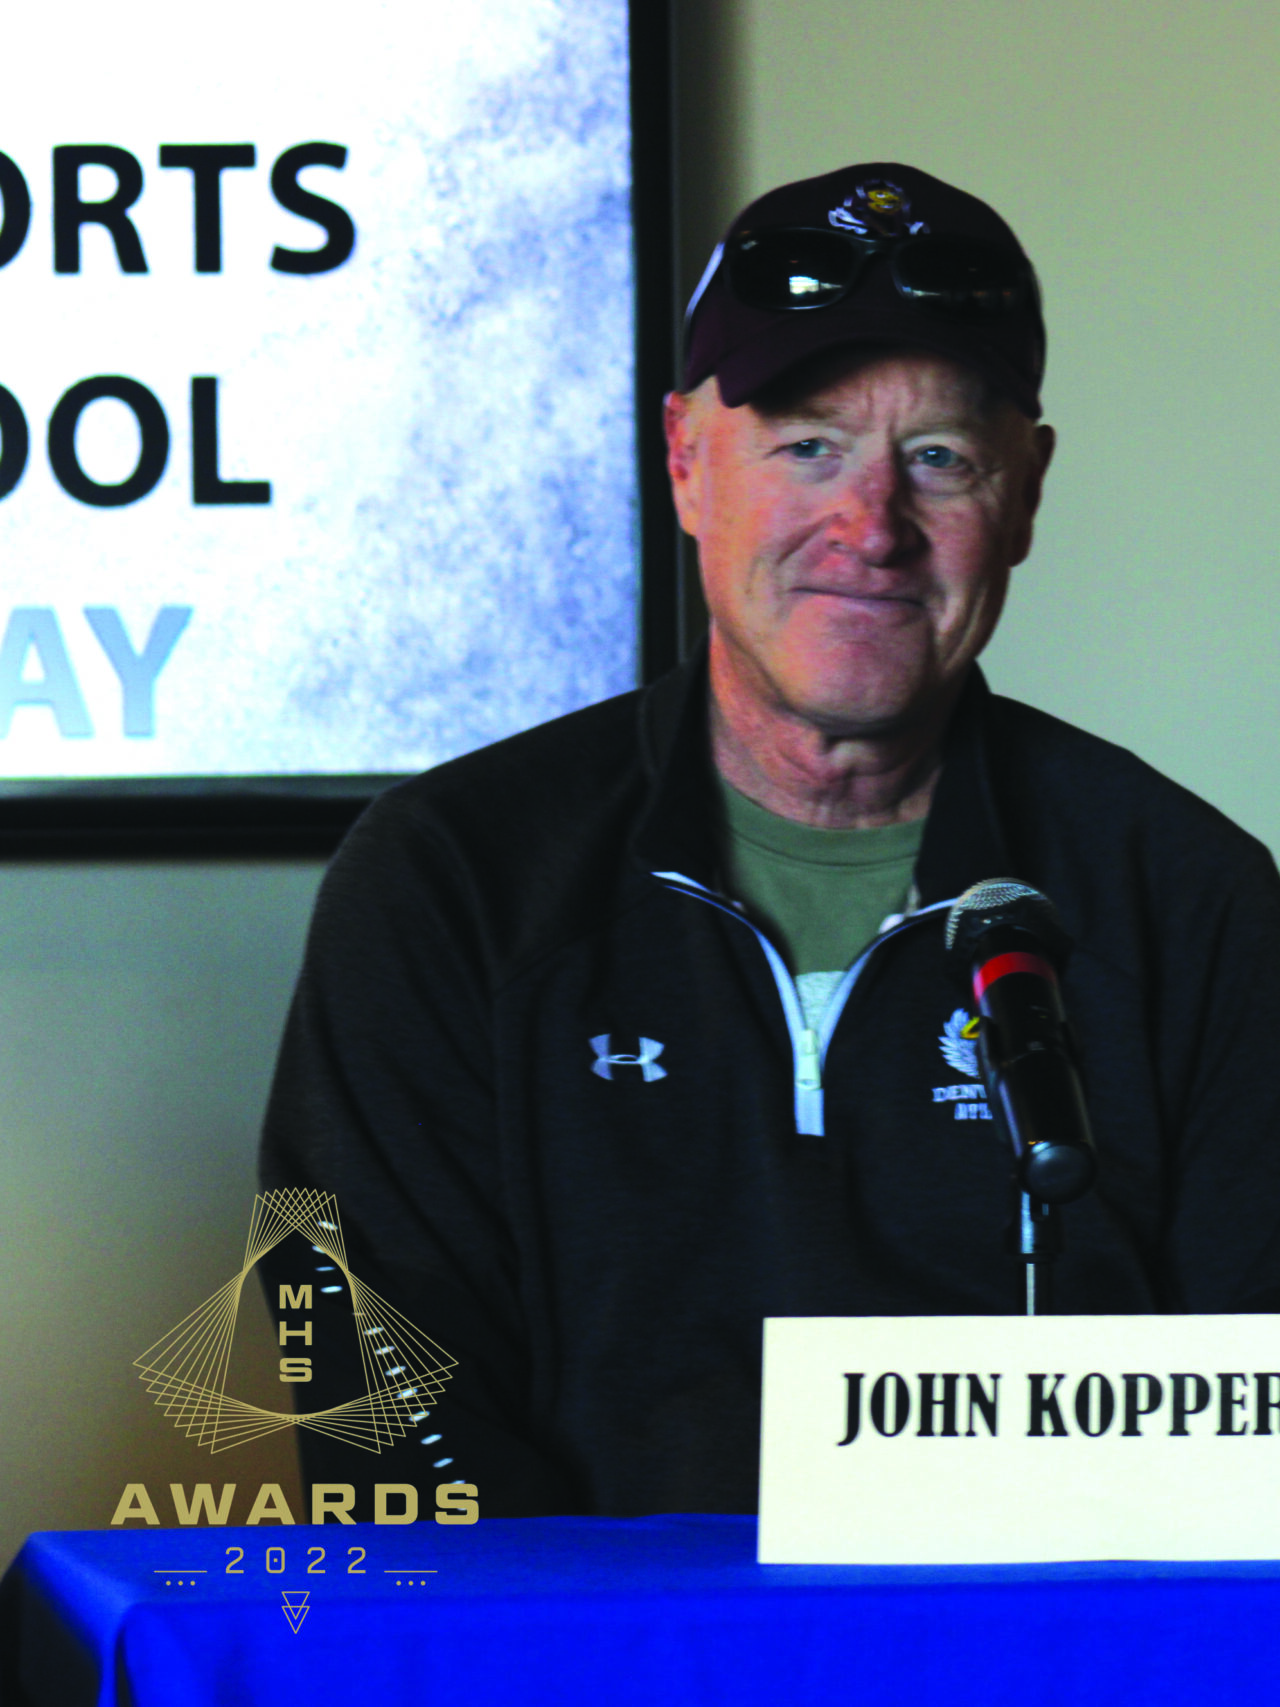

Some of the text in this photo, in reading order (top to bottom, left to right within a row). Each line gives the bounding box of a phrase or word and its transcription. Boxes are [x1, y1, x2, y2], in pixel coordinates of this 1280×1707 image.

[0, 142, 357, 277] RTS
[0, 375, 272, 509] OL
[836, 1371, 1003, 1446] JOHN
